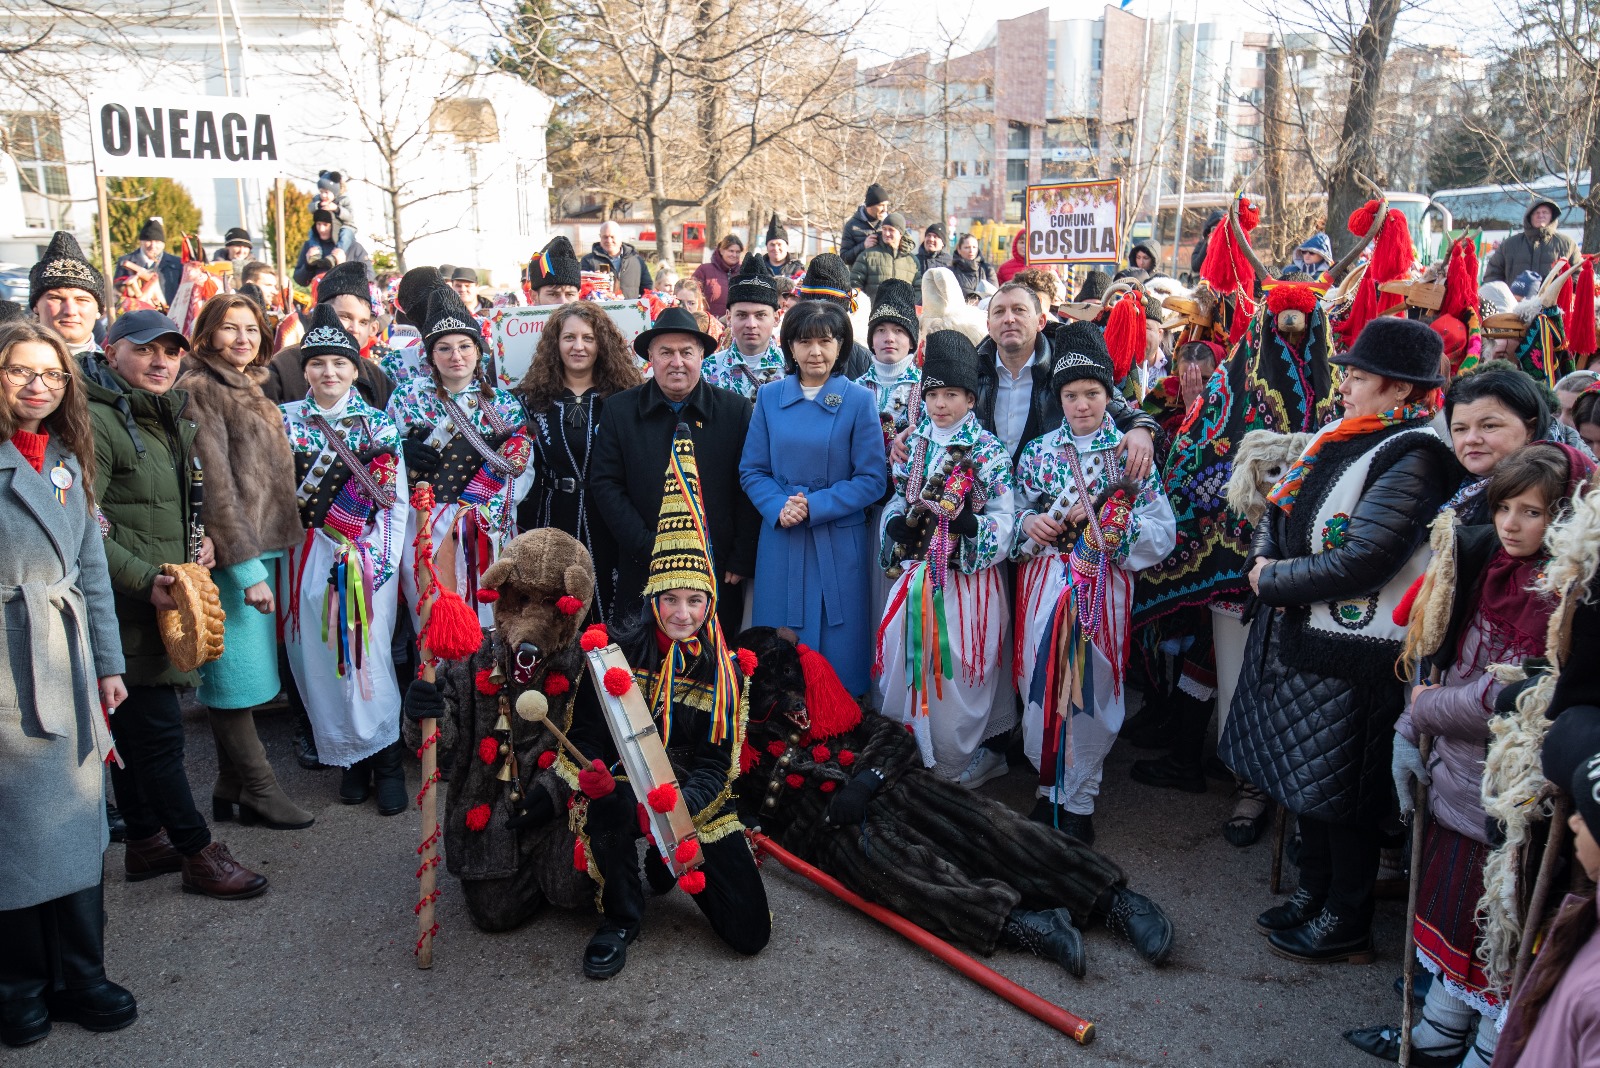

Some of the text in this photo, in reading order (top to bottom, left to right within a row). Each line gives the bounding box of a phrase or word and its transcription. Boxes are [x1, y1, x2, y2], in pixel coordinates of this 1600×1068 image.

[100, 102, 277, 162] ONEAGA
[1050, 213, 1095, 228] COMUNA
[1030, 227, 1116, 259] COȘULA
